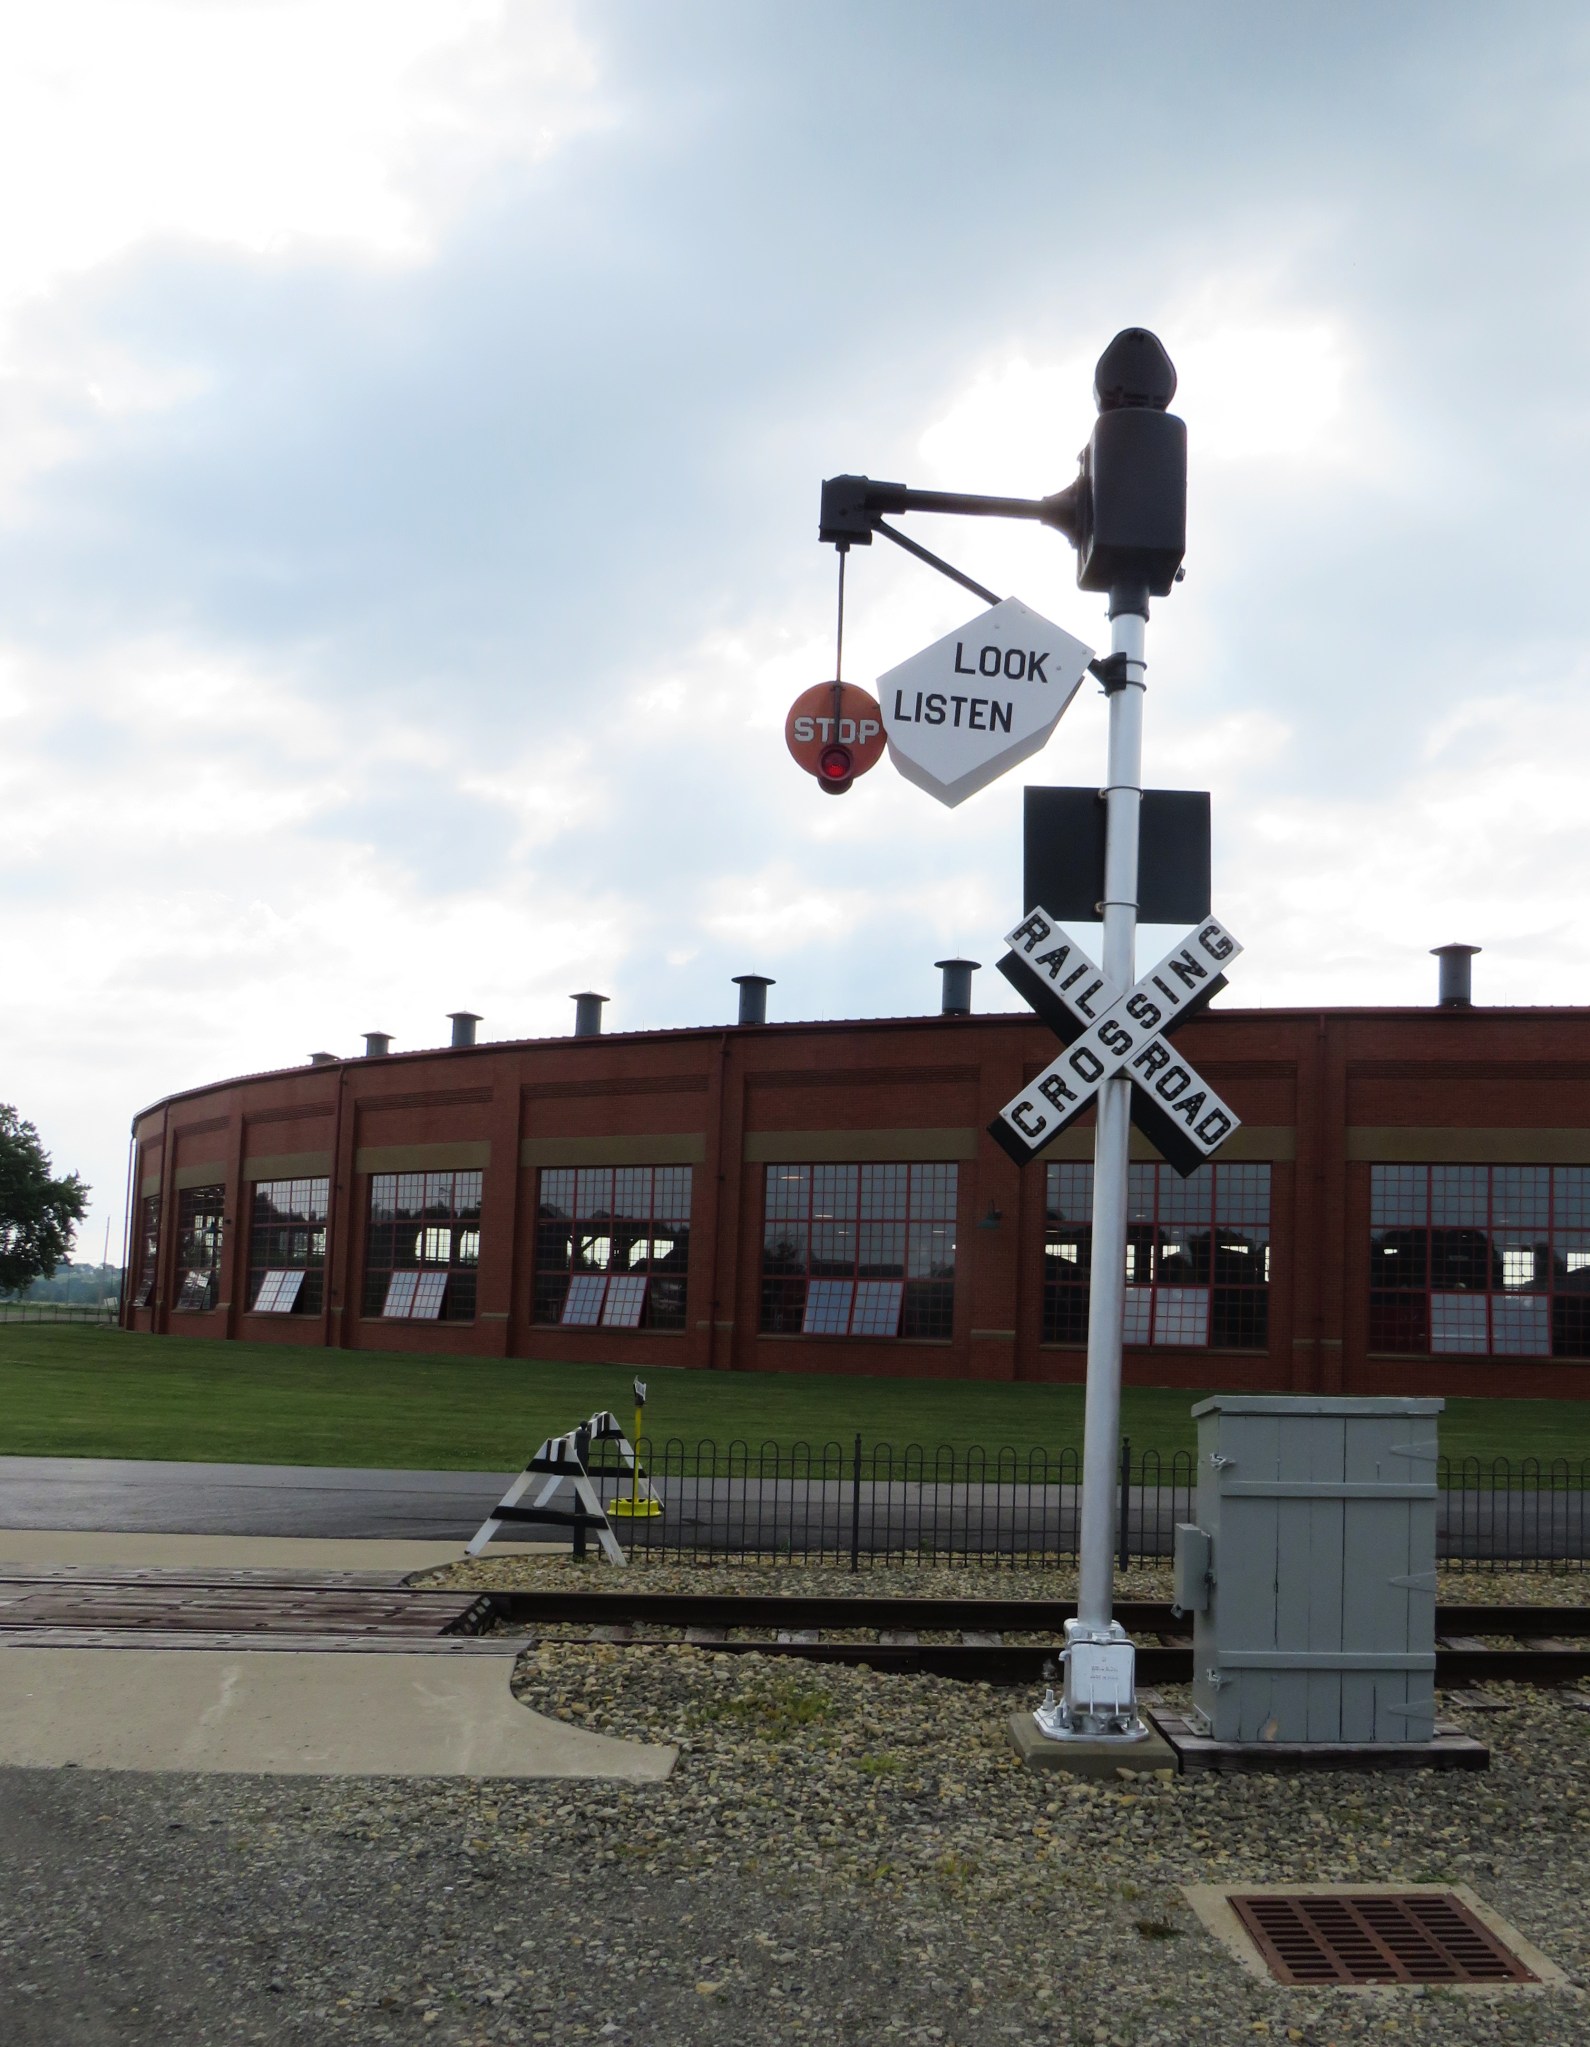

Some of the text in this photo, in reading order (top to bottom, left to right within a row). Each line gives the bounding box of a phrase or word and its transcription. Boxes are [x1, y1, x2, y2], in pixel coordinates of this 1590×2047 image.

[954, 642, 1050, 683] LOOK
[794, 716, 880, 744] STOP
[894, 689, 1013, 733] LISTEN
[1011, 925, 1234, 1138] CROSSING
